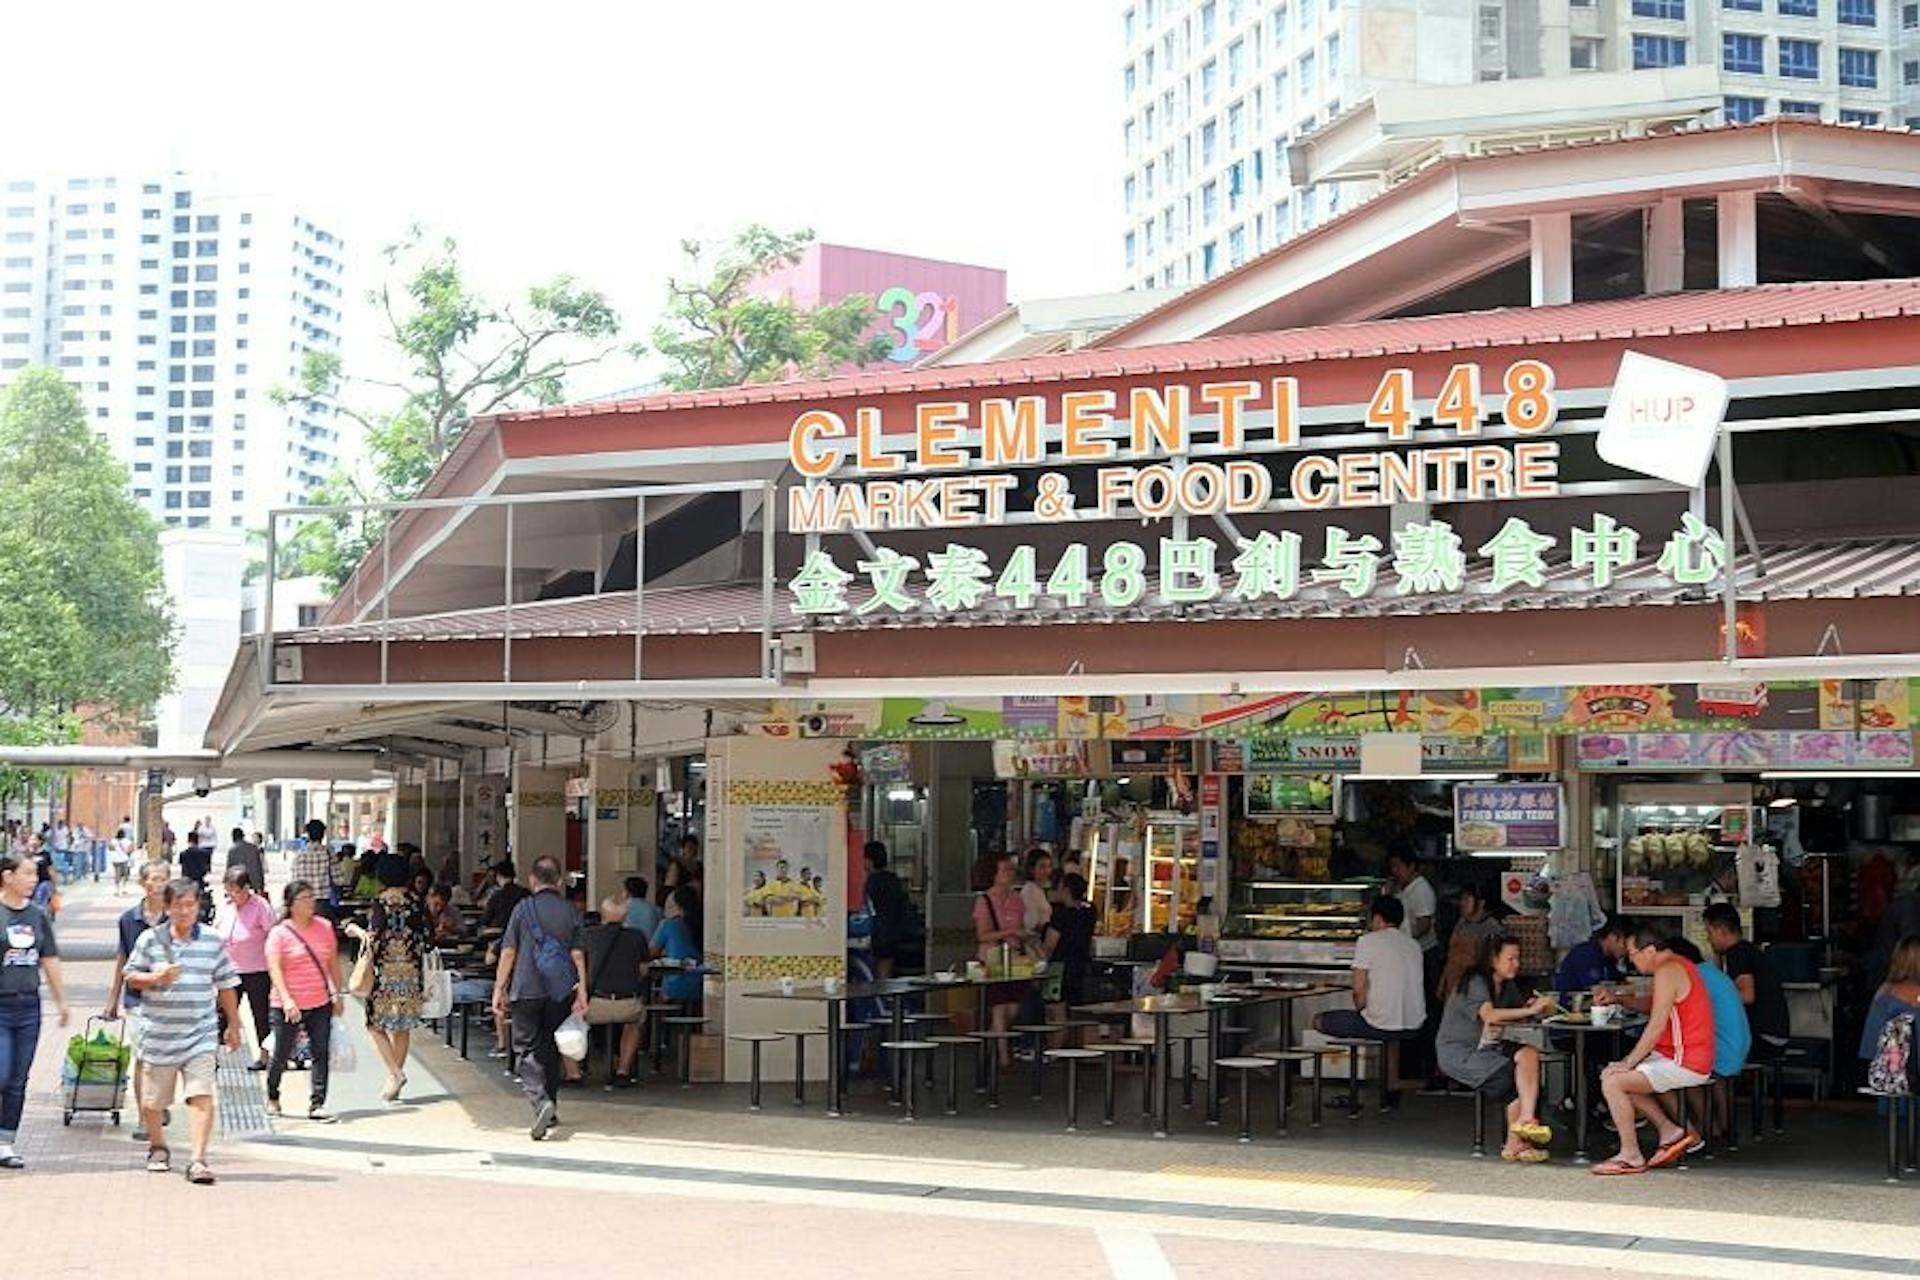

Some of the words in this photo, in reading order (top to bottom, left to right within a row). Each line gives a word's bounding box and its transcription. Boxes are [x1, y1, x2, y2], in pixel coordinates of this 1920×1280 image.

[877, 287, 958, 362] 321
[790, 376, 1300, 477] CLEMENTI
[1365, 359, 1557, 440] 448
[789, 475, 1018, 533] MARKET
[1035, 473, 1073, 521] &
[1098, 461, 1271, 516] FOOD
[1291, 442, 1560, 507] CENTRE
[1296, 745, 1358, 759] SNOW
